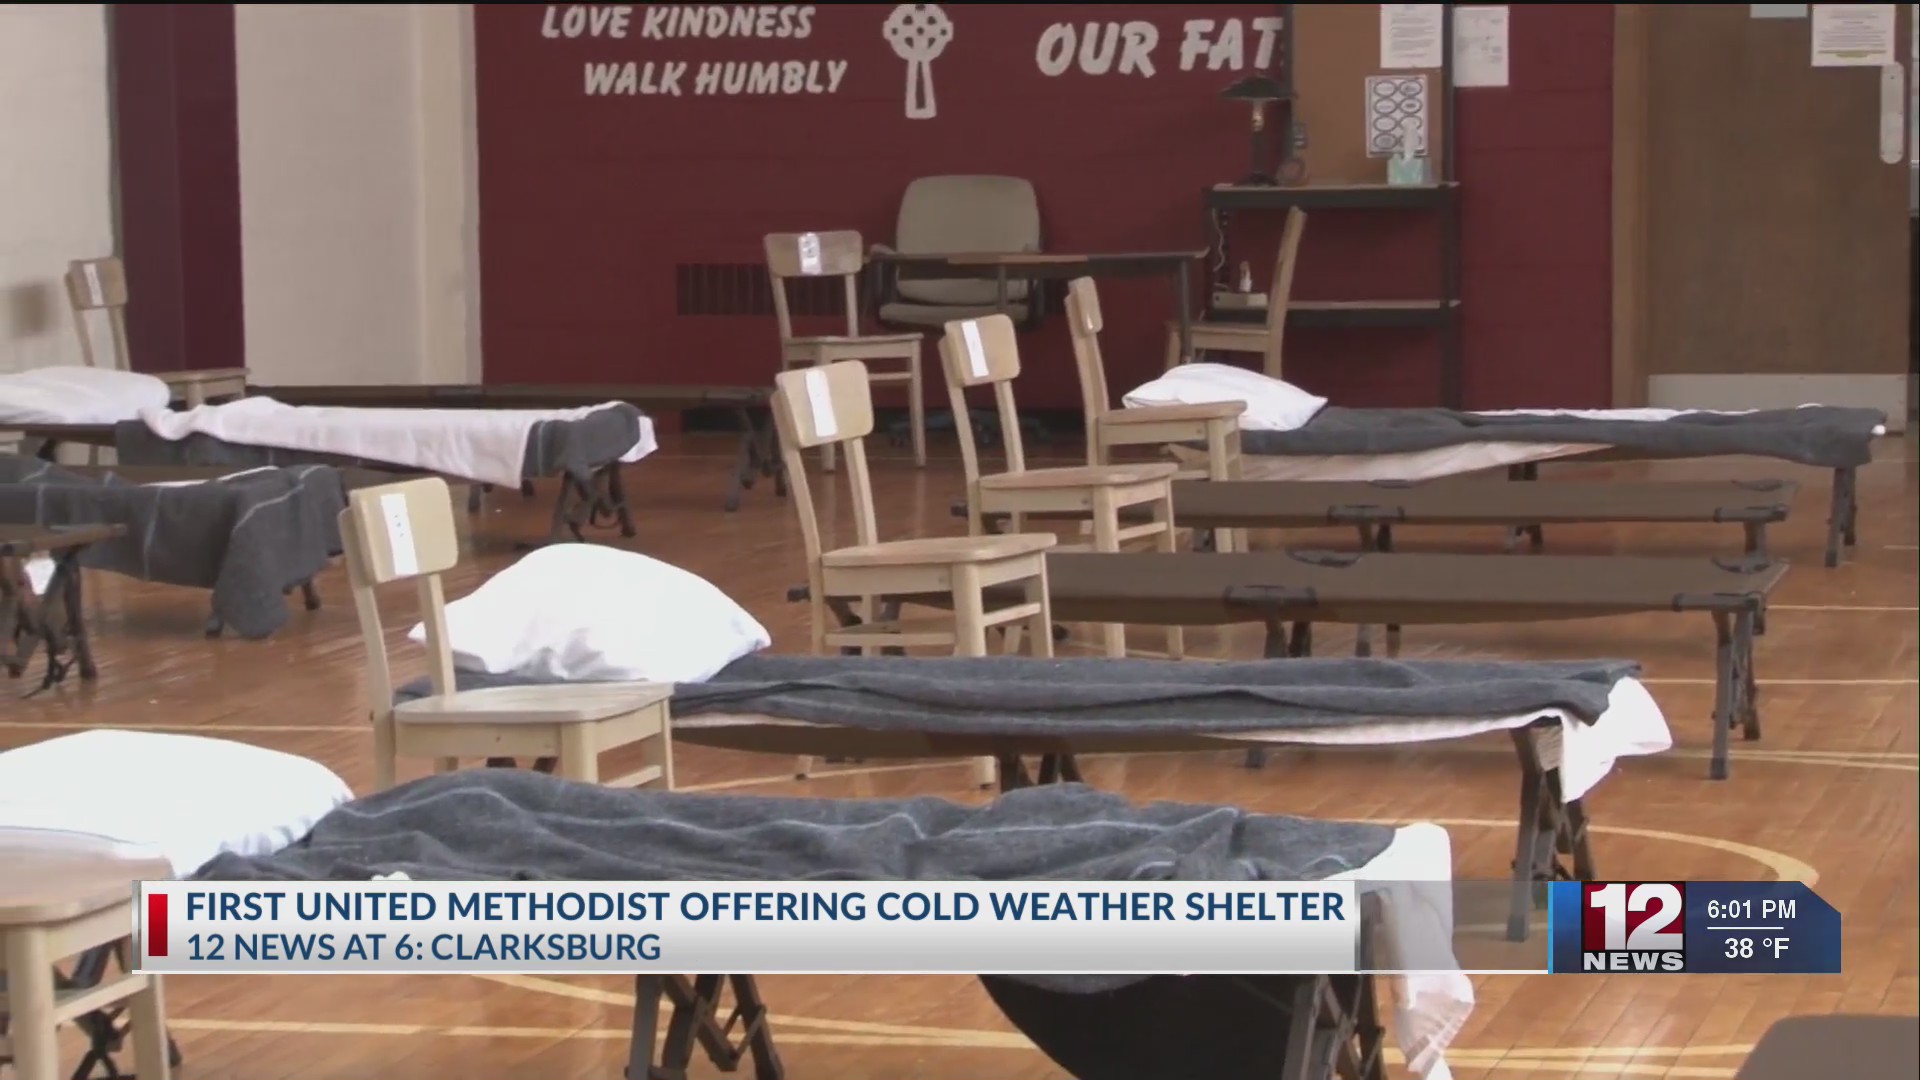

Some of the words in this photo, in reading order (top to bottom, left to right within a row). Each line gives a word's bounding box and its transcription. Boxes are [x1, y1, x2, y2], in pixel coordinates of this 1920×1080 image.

[541, 6, 633, 39] LOVE
[641, 6, 816, 40] KINDNESS
[1035, 21, 1159, 78] OUR
[1178, 17, 1284, 71] FAT
[584, 61, 687, 97] WALK
[695, 60, 848, 95] HUMBLY
